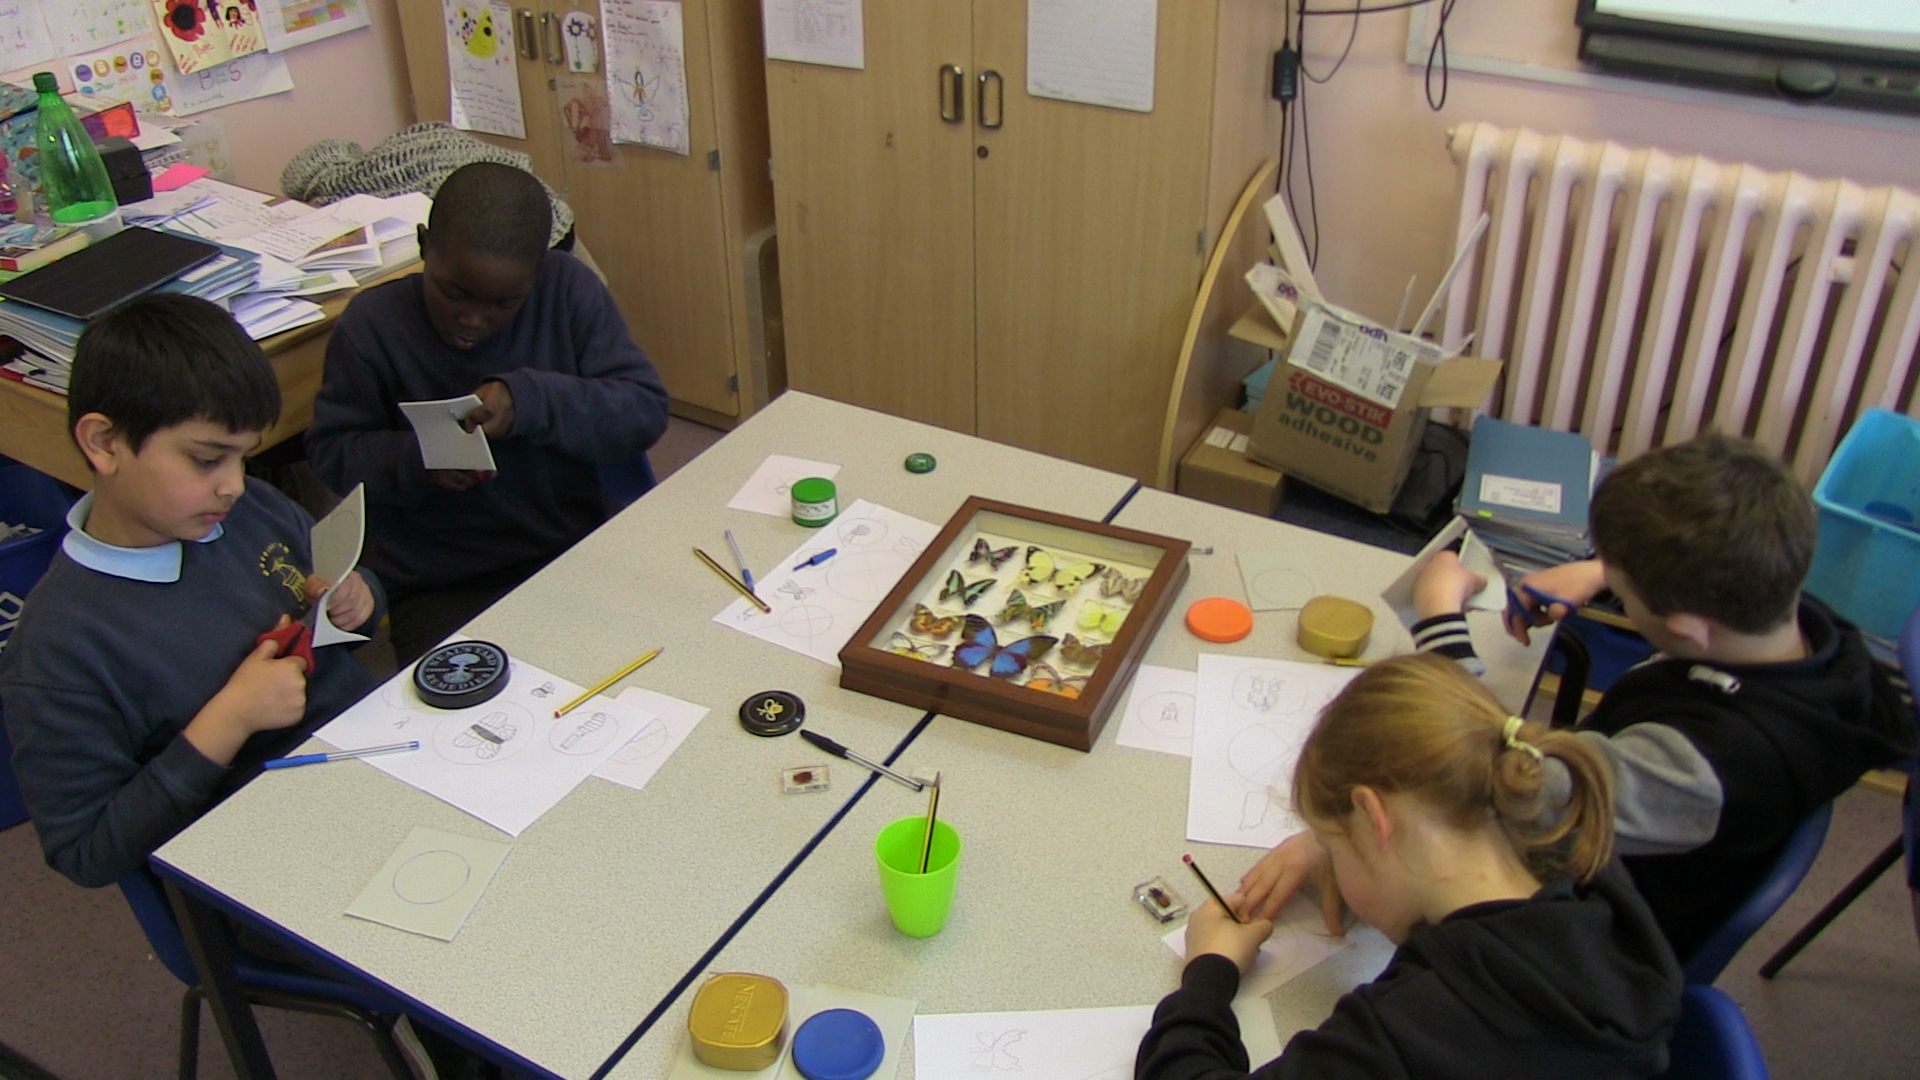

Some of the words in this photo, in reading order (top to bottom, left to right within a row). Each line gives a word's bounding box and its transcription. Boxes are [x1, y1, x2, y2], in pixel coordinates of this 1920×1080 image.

[1285, 391, 1384, 445] WOOD
[1279, 412, 1377, 462] adhesive
[475, 647, 497, 666] YARD
[425, 672, 491, 690] REMEDIES
